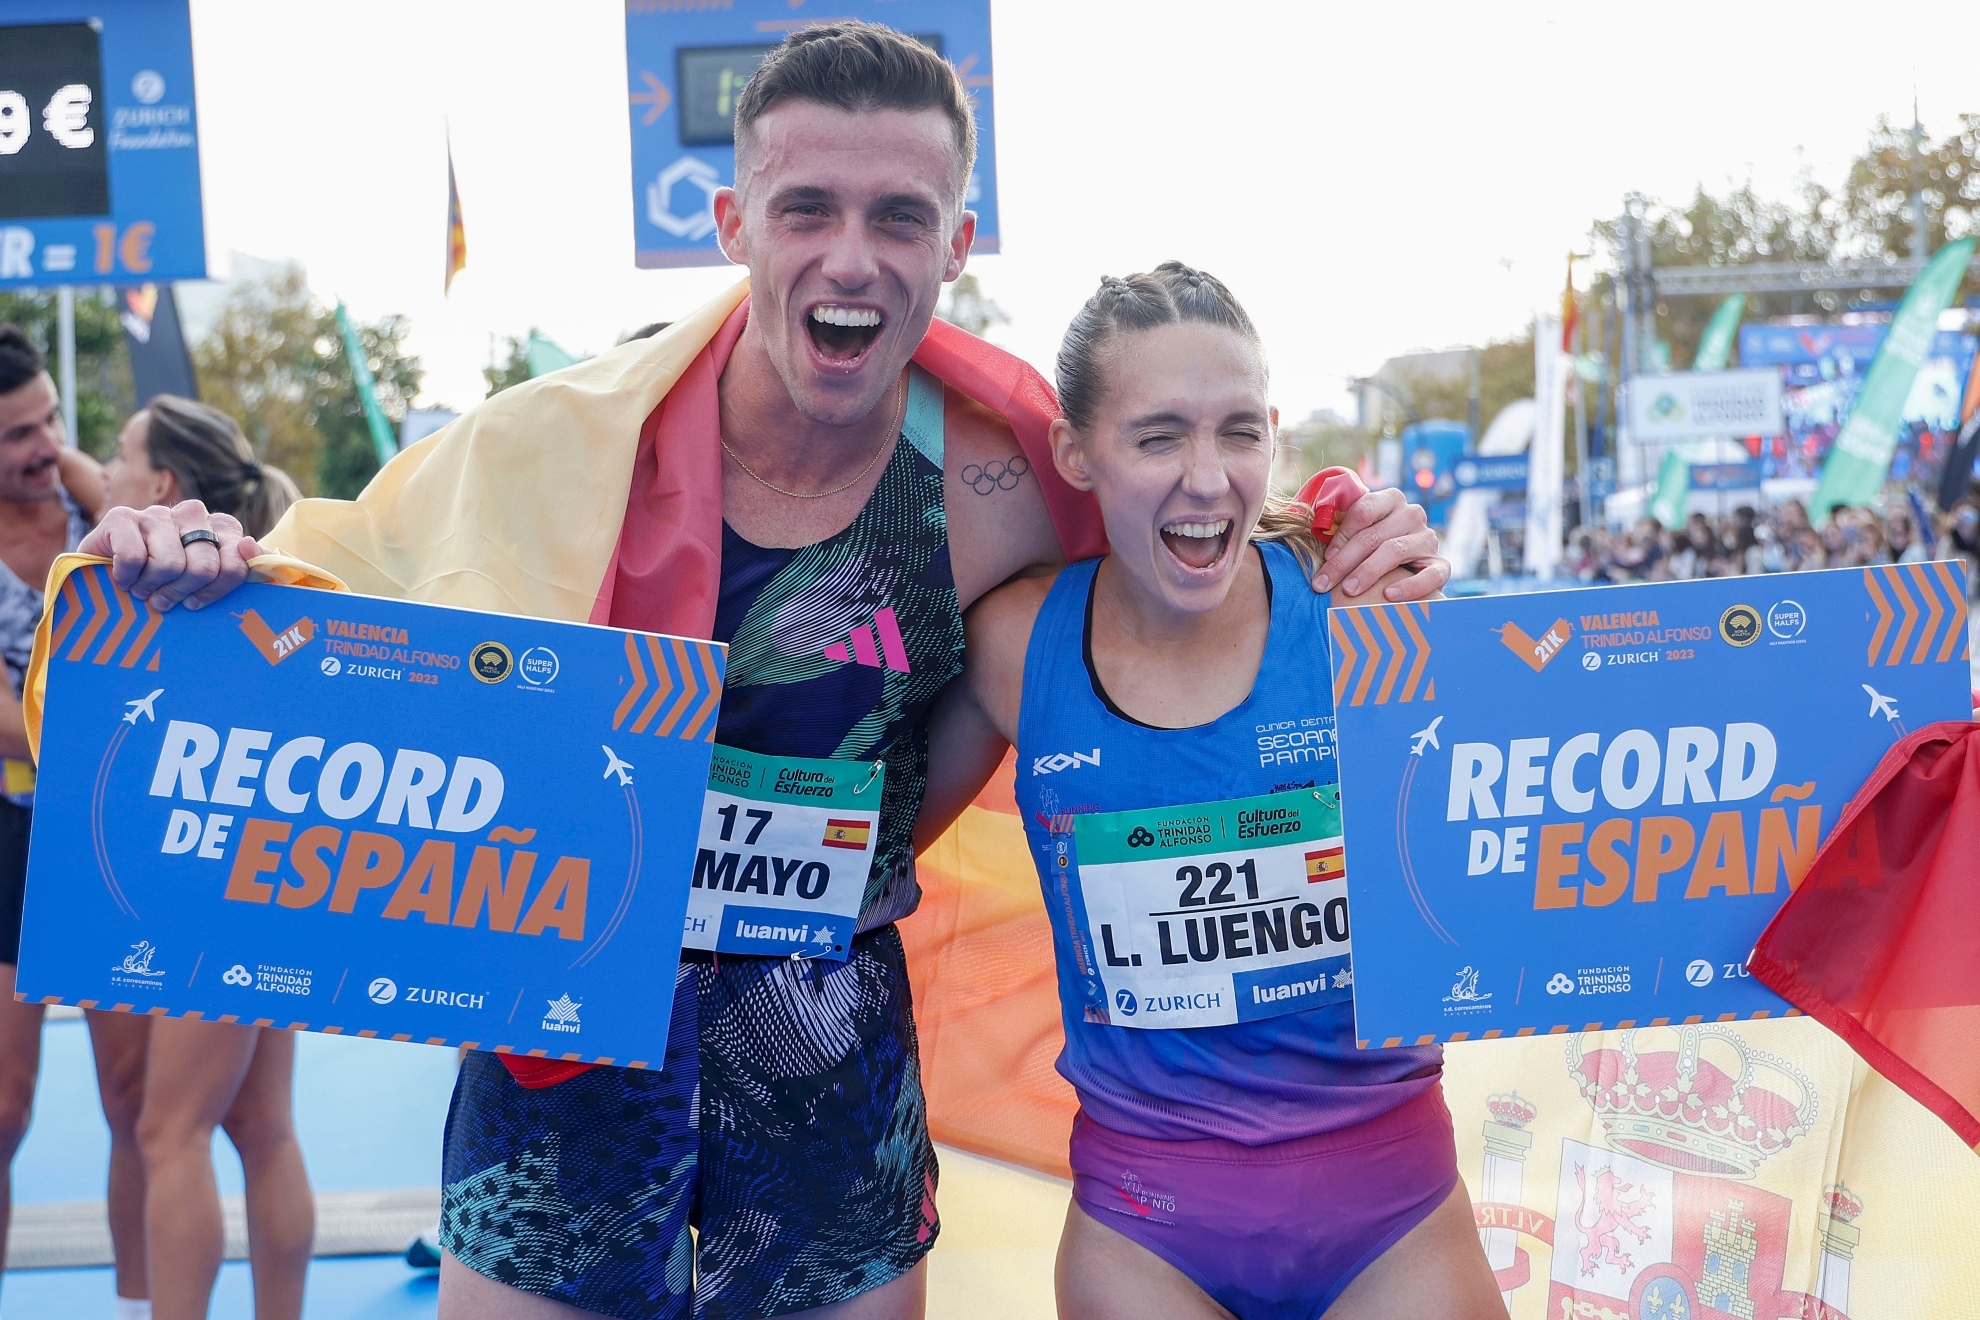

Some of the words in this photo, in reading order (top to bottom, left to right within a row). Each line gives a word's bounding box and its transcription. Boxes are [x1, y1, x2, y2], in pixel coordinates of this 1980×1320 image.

[43, 84, 94, 148] €
[93, 220, 156, 274] 1€
[1580, 611, 1660, 631] VALENCIA
[1774, 612, 1799, 620] SUPER
[1774, 618, 1799, 627] HALFS
[326, 619, 409, 645] VALENCIA
[1581, 631, 1644, 648] TRINIDAD
[1646, 626, 1712, 643] ALFONSO
[272, 626, 306, 658] 21K
[1534, 629, 1564, 664] 21K
[323, 639, 390, 661] TRINIDAD
[391, 648, 461, 670] ALFONSO
[527, 658, 553, 668] SUPER
[1607, 652, 1658, 665] ZURICH
[1665, 649, 1695, 660] 2023
[346, 664, 402, 680] ZURICH
[408, 672, 439, 685] 2023
[526, 665, 552, 674] HALFS
[1256, 720, 1296, 733] CLINICA
[1300, 715, 1335, 727] DENTA
[713, 756, 753, 770] NDACIÓN
[1260, 746, 1336, 768] PAMPI
[149, 720, 505, 833] RECORD
[709, 763, 751, 780] RINIDAD
[778, 768, 824, 783] Cultura
[1446, 722, 1777, 822] RECORD
[709, 776, 749, 788] FONSO
[774, 781, 833, 797] Esfuerzo
[717, 804, 773, 845] 17
[1237, 808, 1286, 824] Cultura
[1288, 809, 1299, 817] del
[1158, 824, 1211, 838] TRINIDAD
[1238, 820, 1301, 839] Esfuerzo
[1159, 834, 1212, 848] ALFONSO
[1467, 826, 1529, 877] DE
[161, 809, 234, 859] DE
[224, 817, 590, 941] ESPAÑA
[691, 848, 831, 900] MAYO
[1175, 858, 1259, 908] 221
[736, 920, 808, 942] luanvi
[1101, 923, 1143, 967] L.
[1157, 896, 1349, 966] LUENGO
[256, 972, 312, 986] TRINIDAD
[258, 964, 313, 976] FUNDACIÓN
[1577, 965, 1630, 975] FUNDACIÓN
[1253, 973, 1327, 1004] luanvi
[1577, 973, 1631, 986] TRINIDAD
[255, 983, 311, 996] ALFONSO
[405, 987, 484, 1009] ZURICH
[1578, 983, 1631, 996] ALFONSO
[1144, 992, 1221, 1012] ZURICH
[542, 1020, 581, 1034] luanvi
[1140, 1196, 1176, 1212] PNTO
[1141, 1190, 1175, 1202] RUNNING
